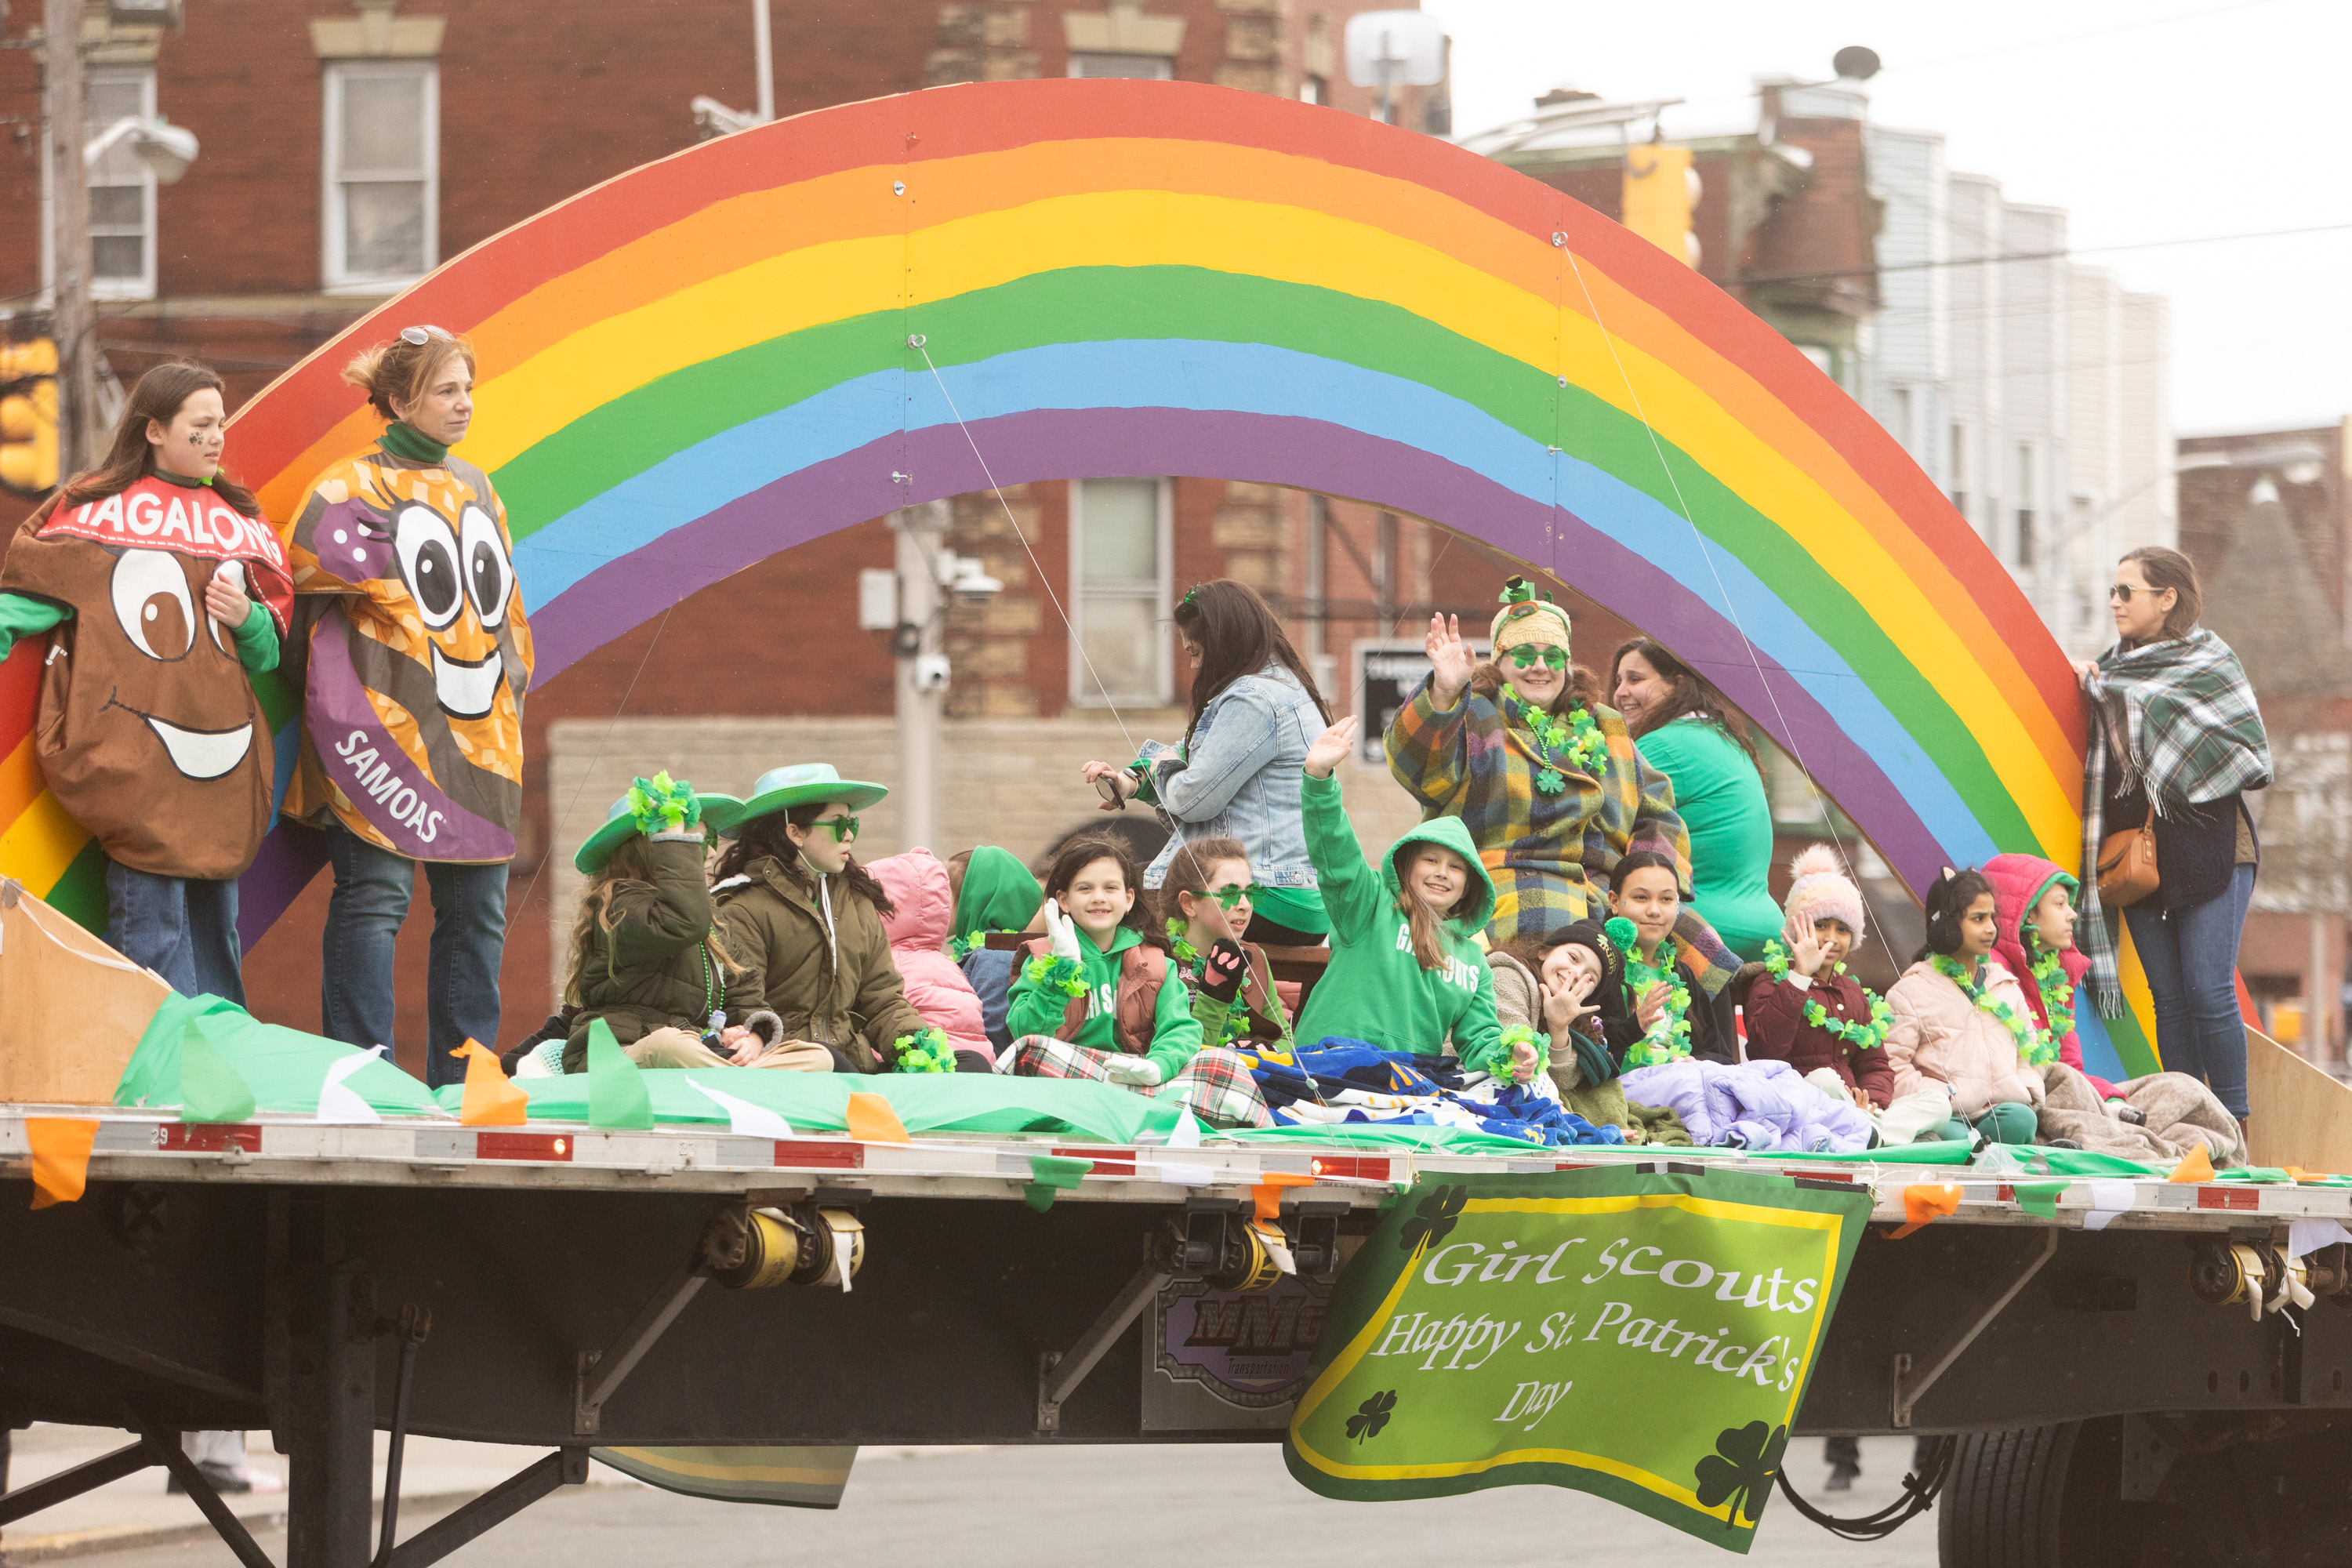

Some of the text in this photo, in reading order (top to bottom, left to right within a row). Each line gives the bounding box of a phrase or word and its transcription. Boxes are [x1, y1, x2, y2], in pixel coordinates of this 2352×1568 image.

[335, 730, 444, 844] SAMOAS
[1436, 954, 1479, 993] OUTS
[151, 1127, 169, 1145] 29
[1423, 1237, 1818, 1314] Girl Scouts
[1187, 1295, 1327, 1352] MMG
[1369, 1301, 1799, 1392] Happy St. Patrick's
[1228, 1357, 1290, 1378] Transportation
[1492, 1380, 1573, 1432] Day
